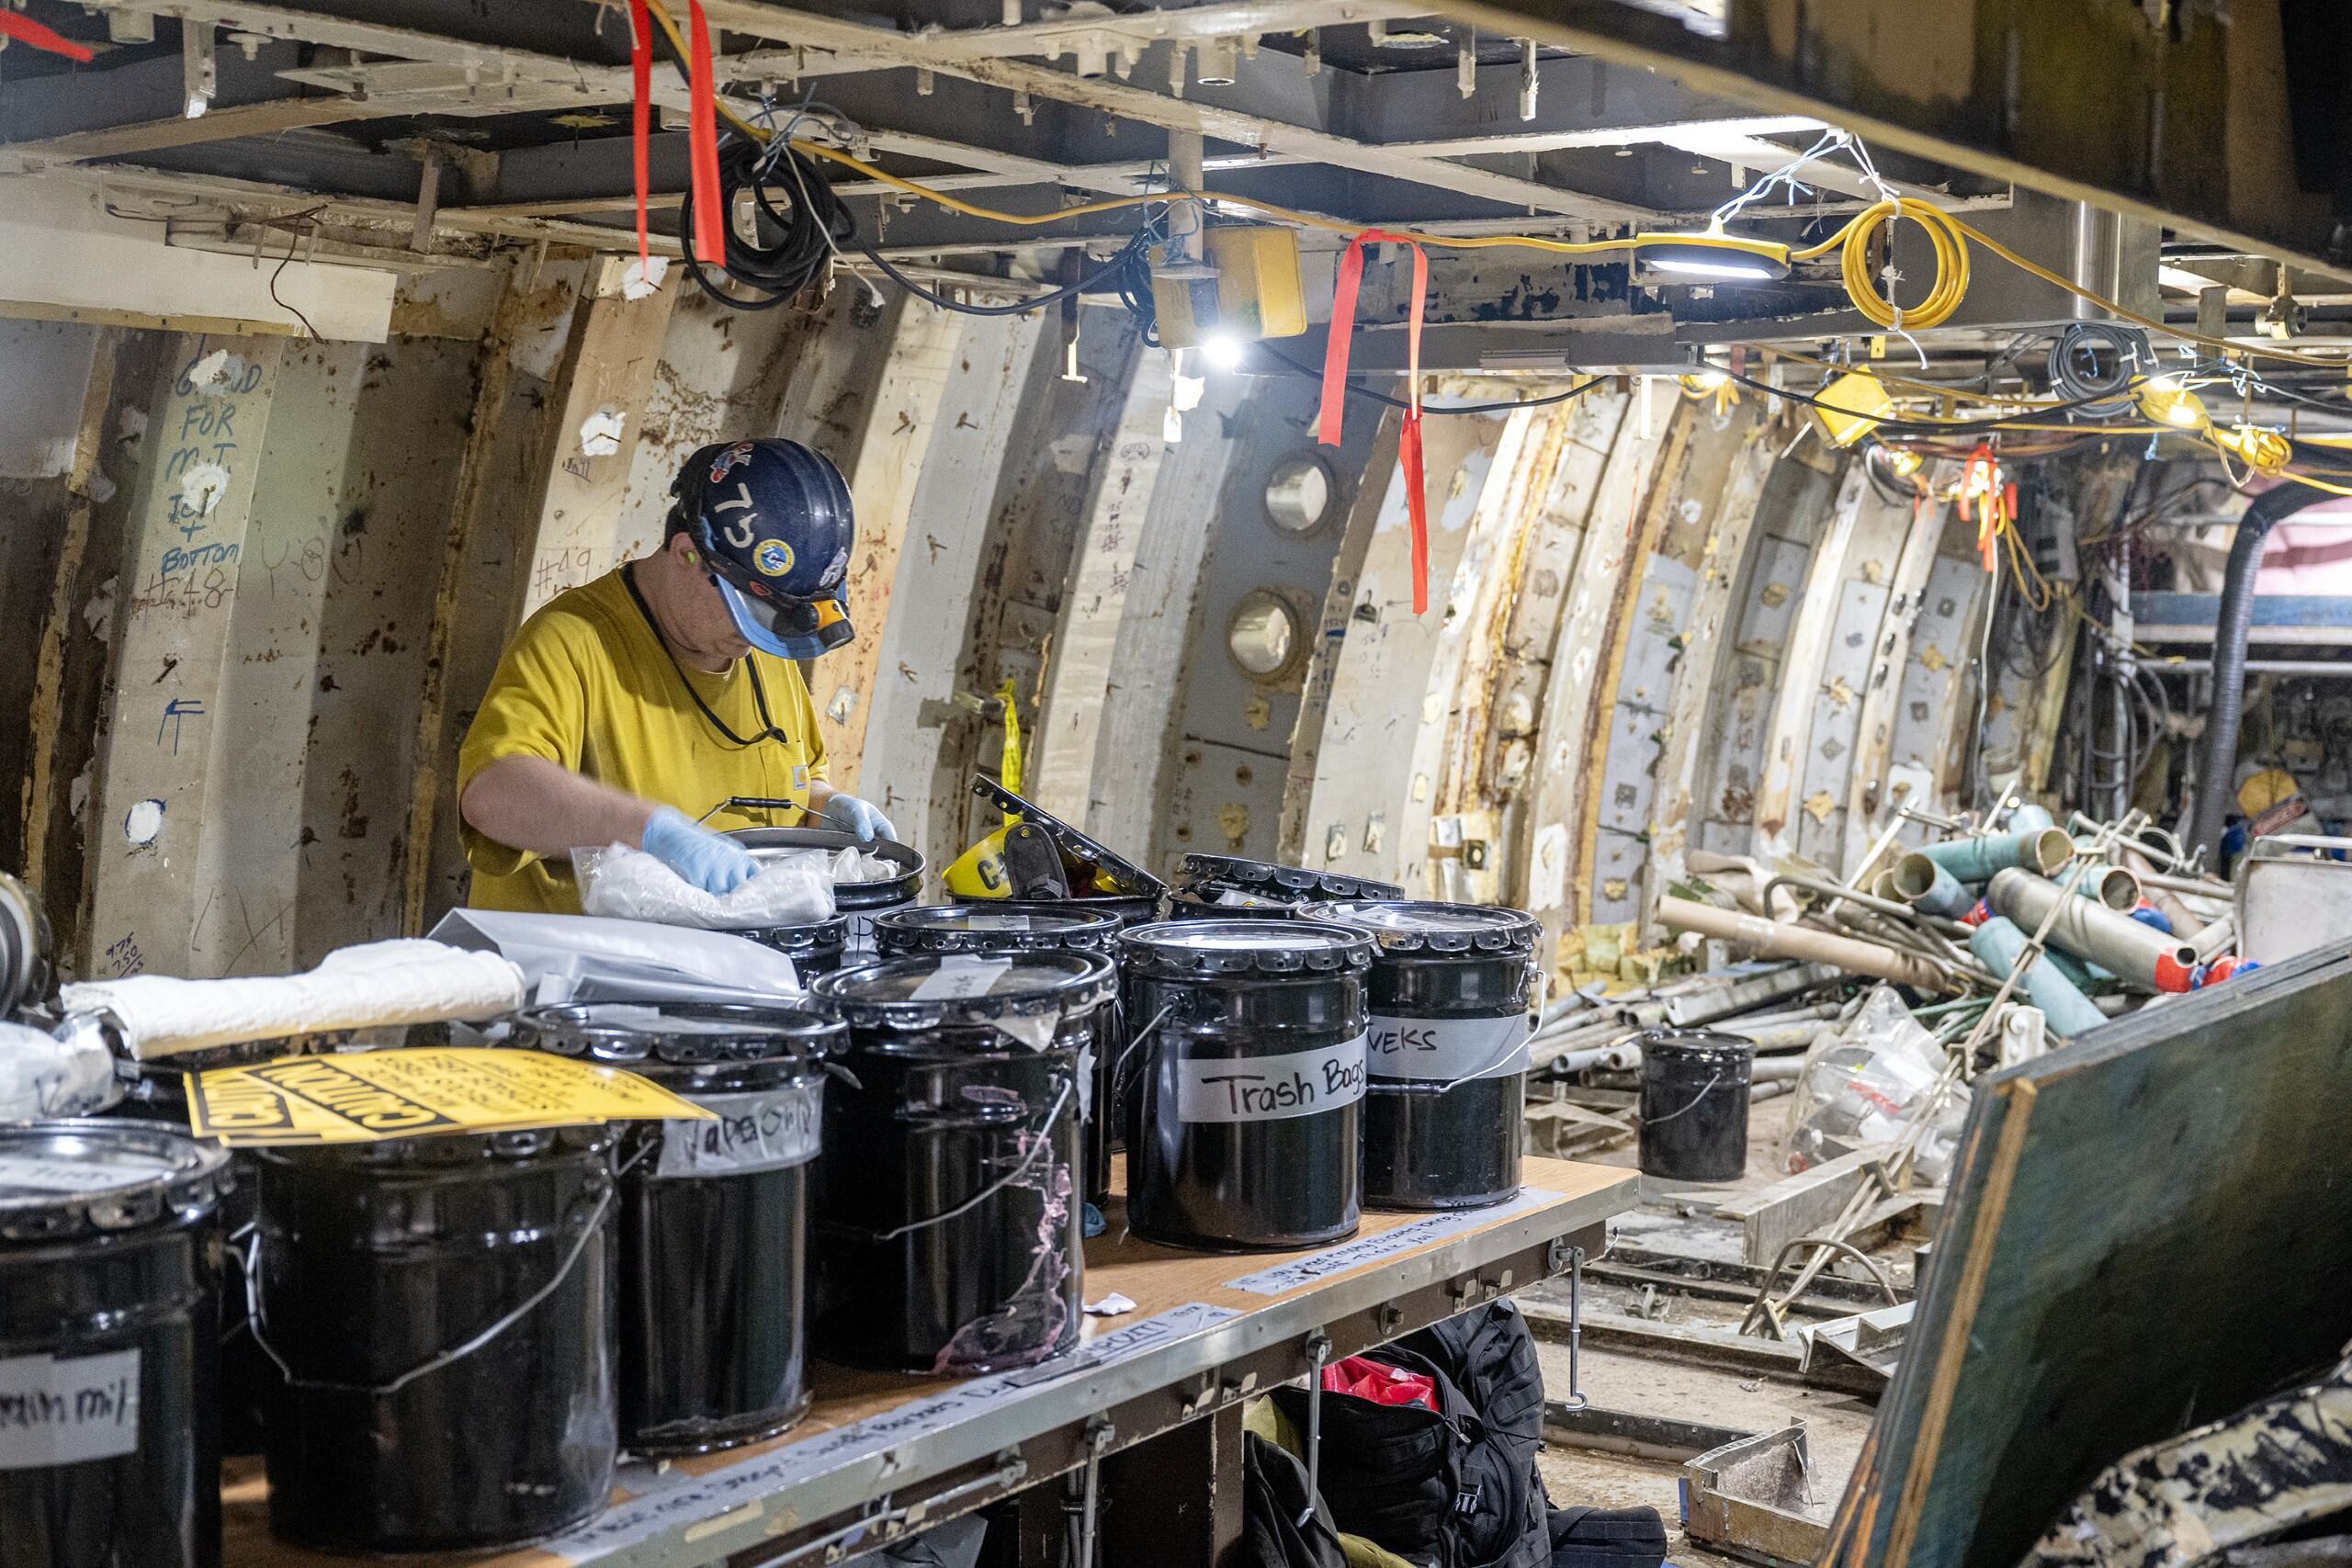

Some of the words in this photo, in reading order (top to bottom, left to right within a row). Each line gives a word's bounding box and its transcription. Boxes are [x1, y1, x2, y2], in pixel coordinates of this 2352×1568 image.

[181, 402, 236, 441] FOR
[161, 544, 239, 574] BOTTOM
[1201, 1071, 1315, 1114] Trash
[1322, 1057, 1365, 1096] Bags
